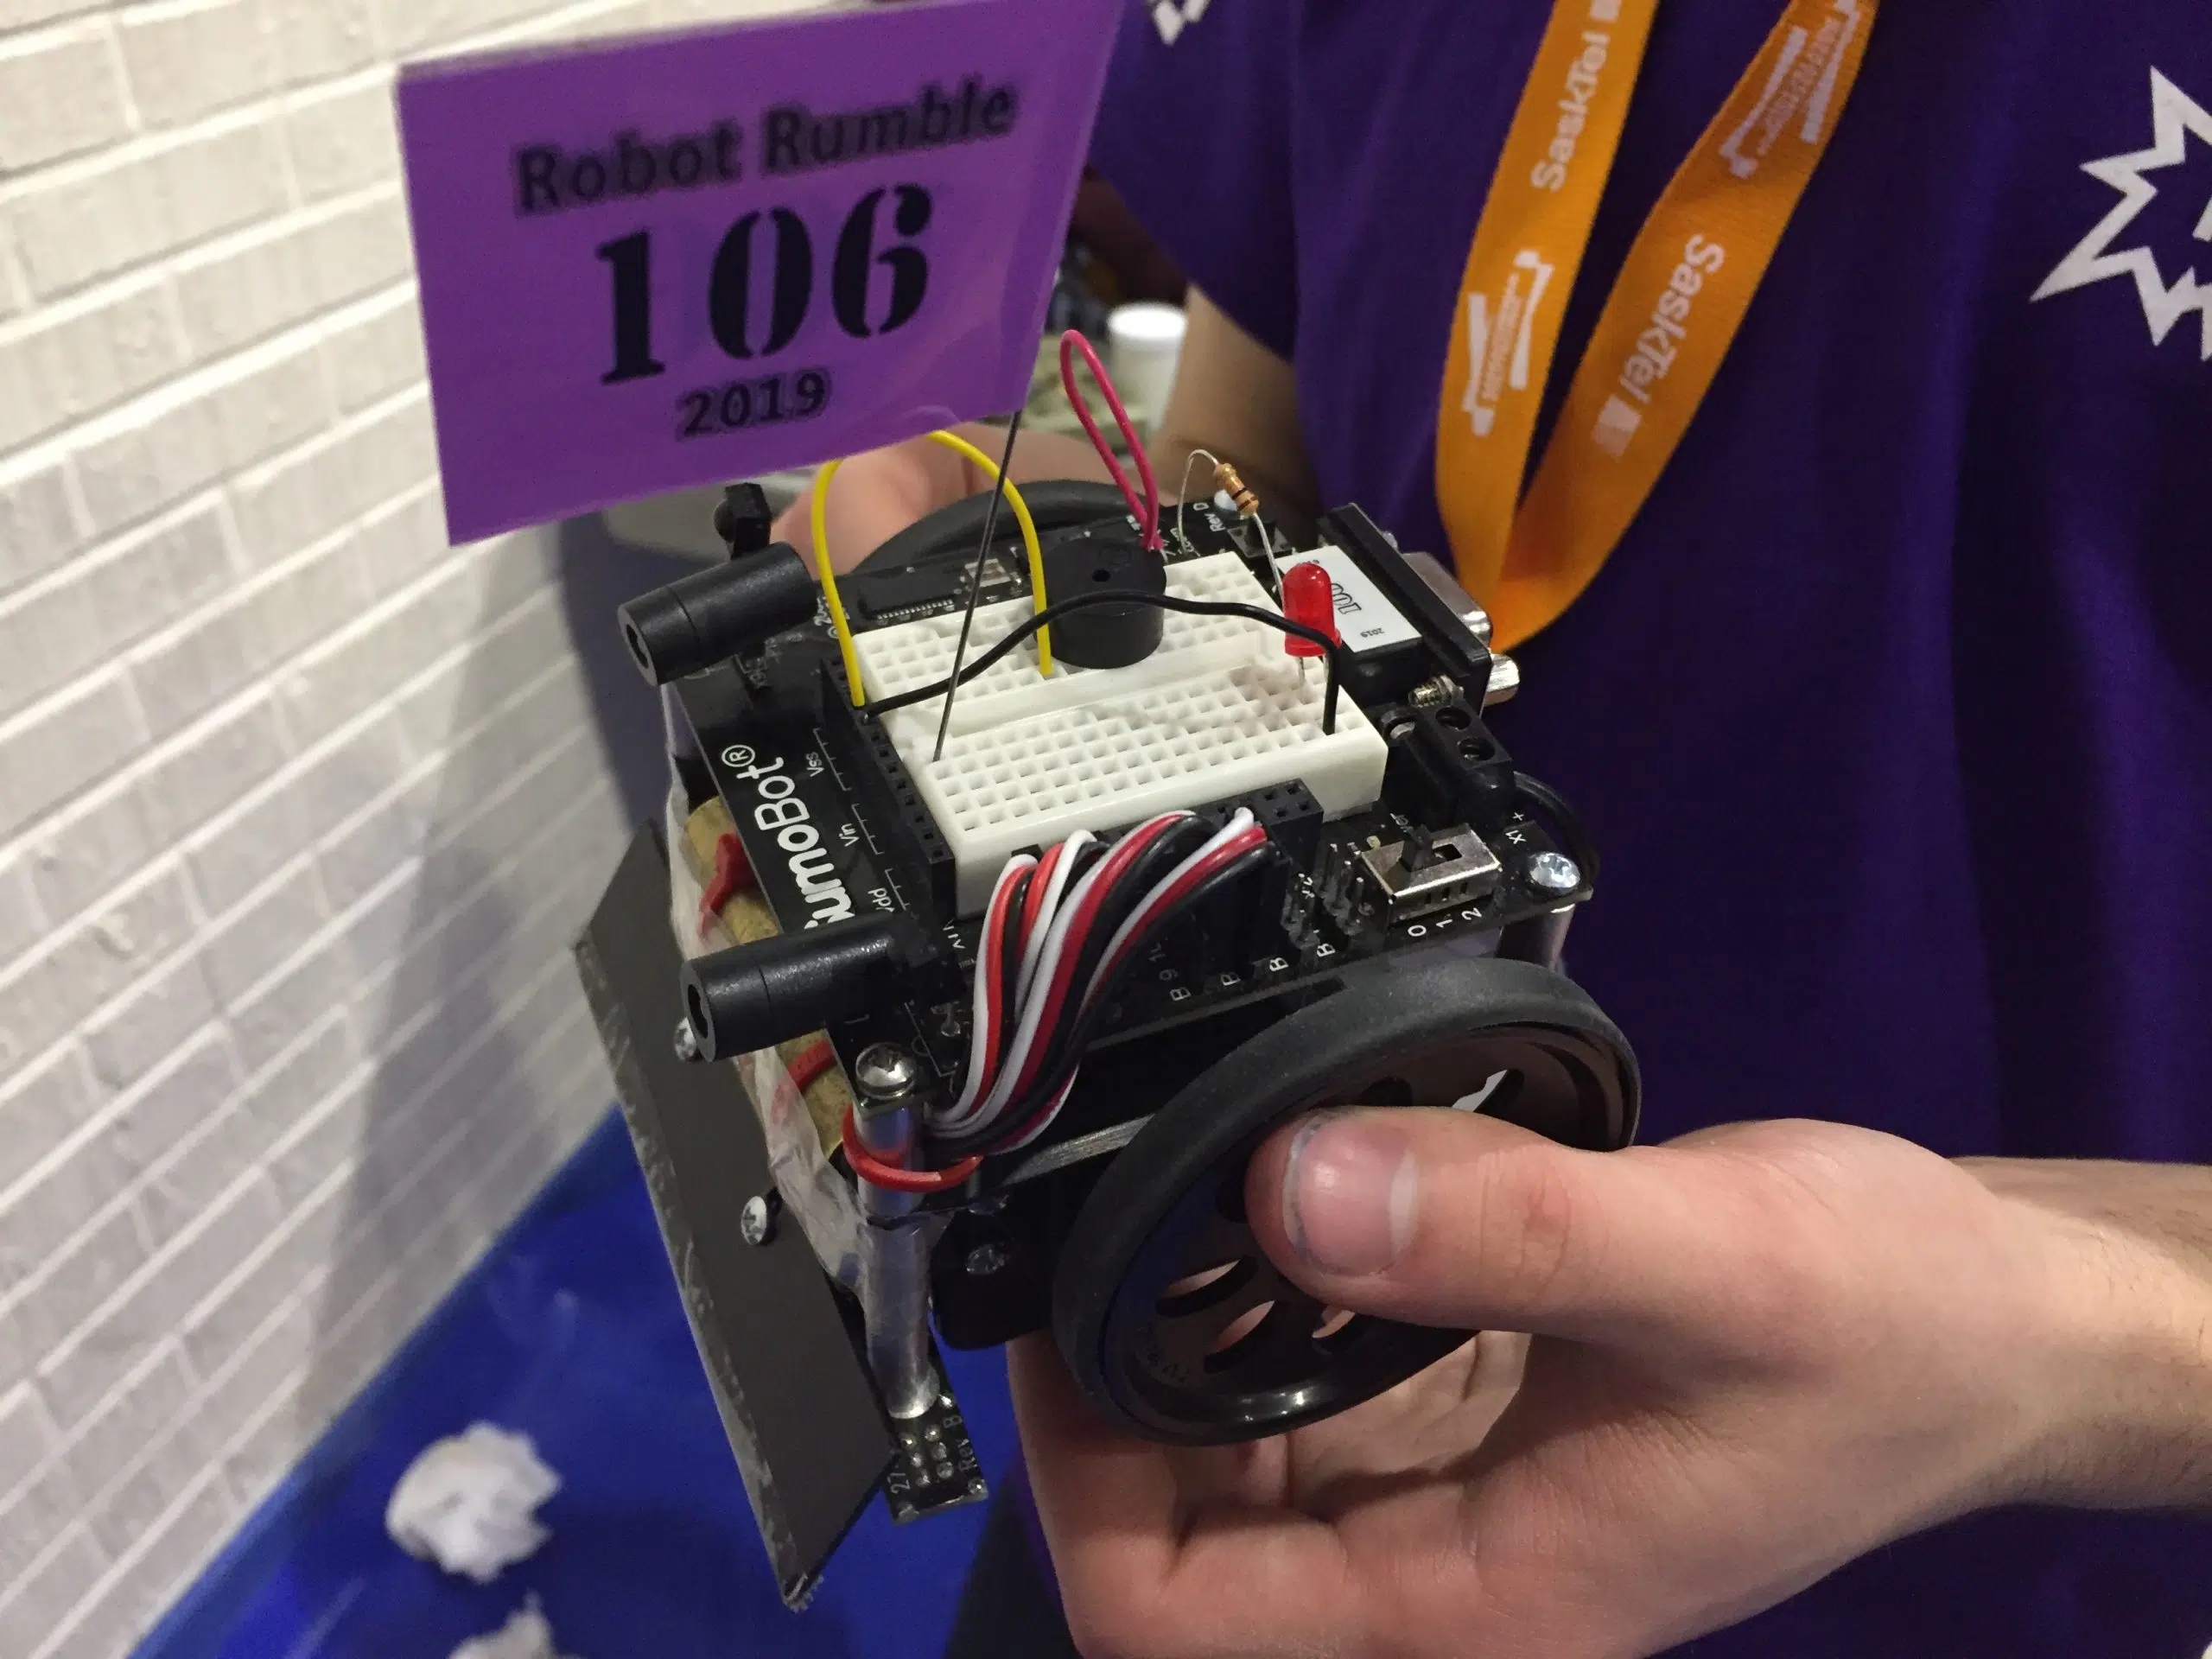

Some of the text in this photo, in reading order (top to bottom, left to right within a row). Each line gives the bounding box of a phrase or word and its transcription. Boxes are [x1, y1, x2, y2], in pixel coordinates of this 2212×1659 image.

[517, 74, 1020, 214] Robot Rumble
[595, 182, 933, 378] 106
[1618, 233, 1725, 404] SaskTel
[677, 366, 830, 438] 2019
[1359, 627, 1386, 639] 2019
[838, 822, 860, 848] Vin
[1461, 906, 1483, 921] 2
